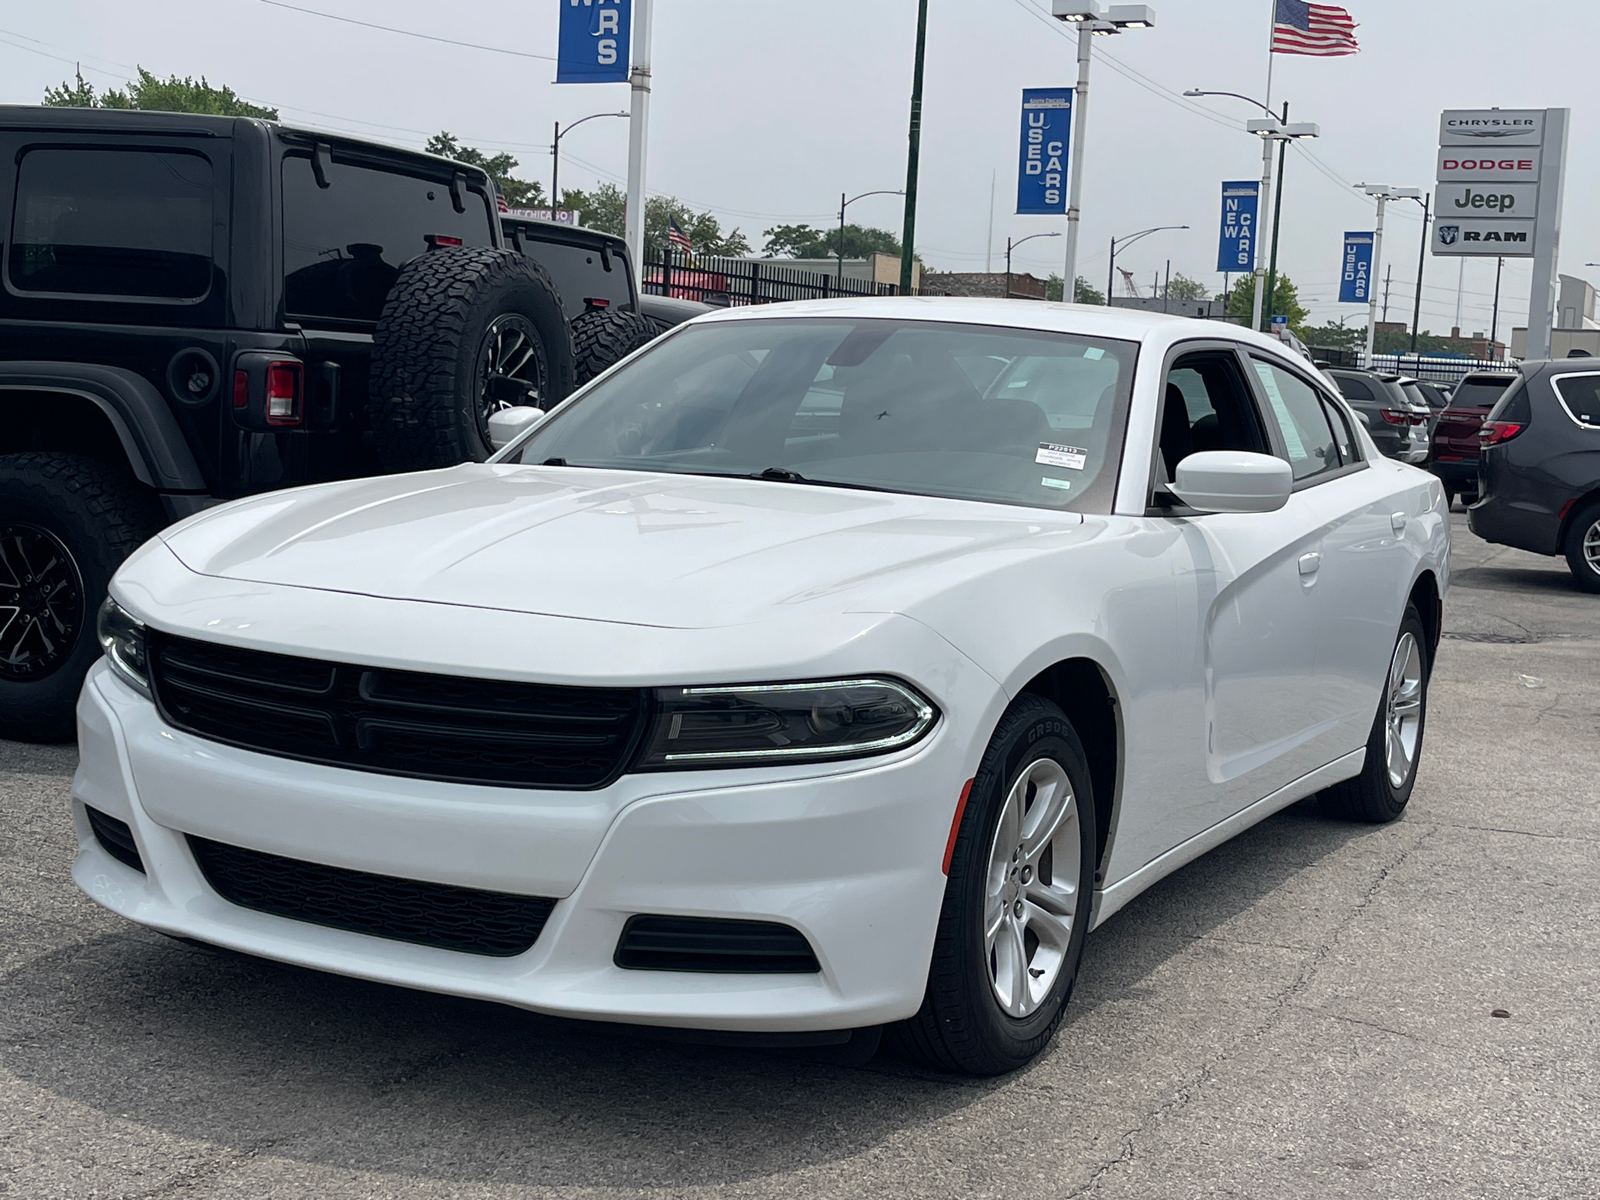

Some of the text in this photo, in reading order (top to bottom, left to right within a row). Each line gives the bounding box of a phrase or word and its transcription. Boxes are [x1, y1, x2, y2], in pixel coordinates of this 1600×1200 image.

[1025, 112, 1045, 175] USED
[1044, 141, 1063, 204] CARS
[1442, 159, 1533, 170] DODGE
[1224, 198, 1238, 239] NEW
[1454, 188, 1515, 213] Jeep
[1237, 213, 1252, 265] CARS
[1463, 231, 1527, 242] RAM
[1344, 245, 1357, 281] USED
[1355, 261, 1367, 298] CARS
[1027, 721, 1069, 744] GR906
